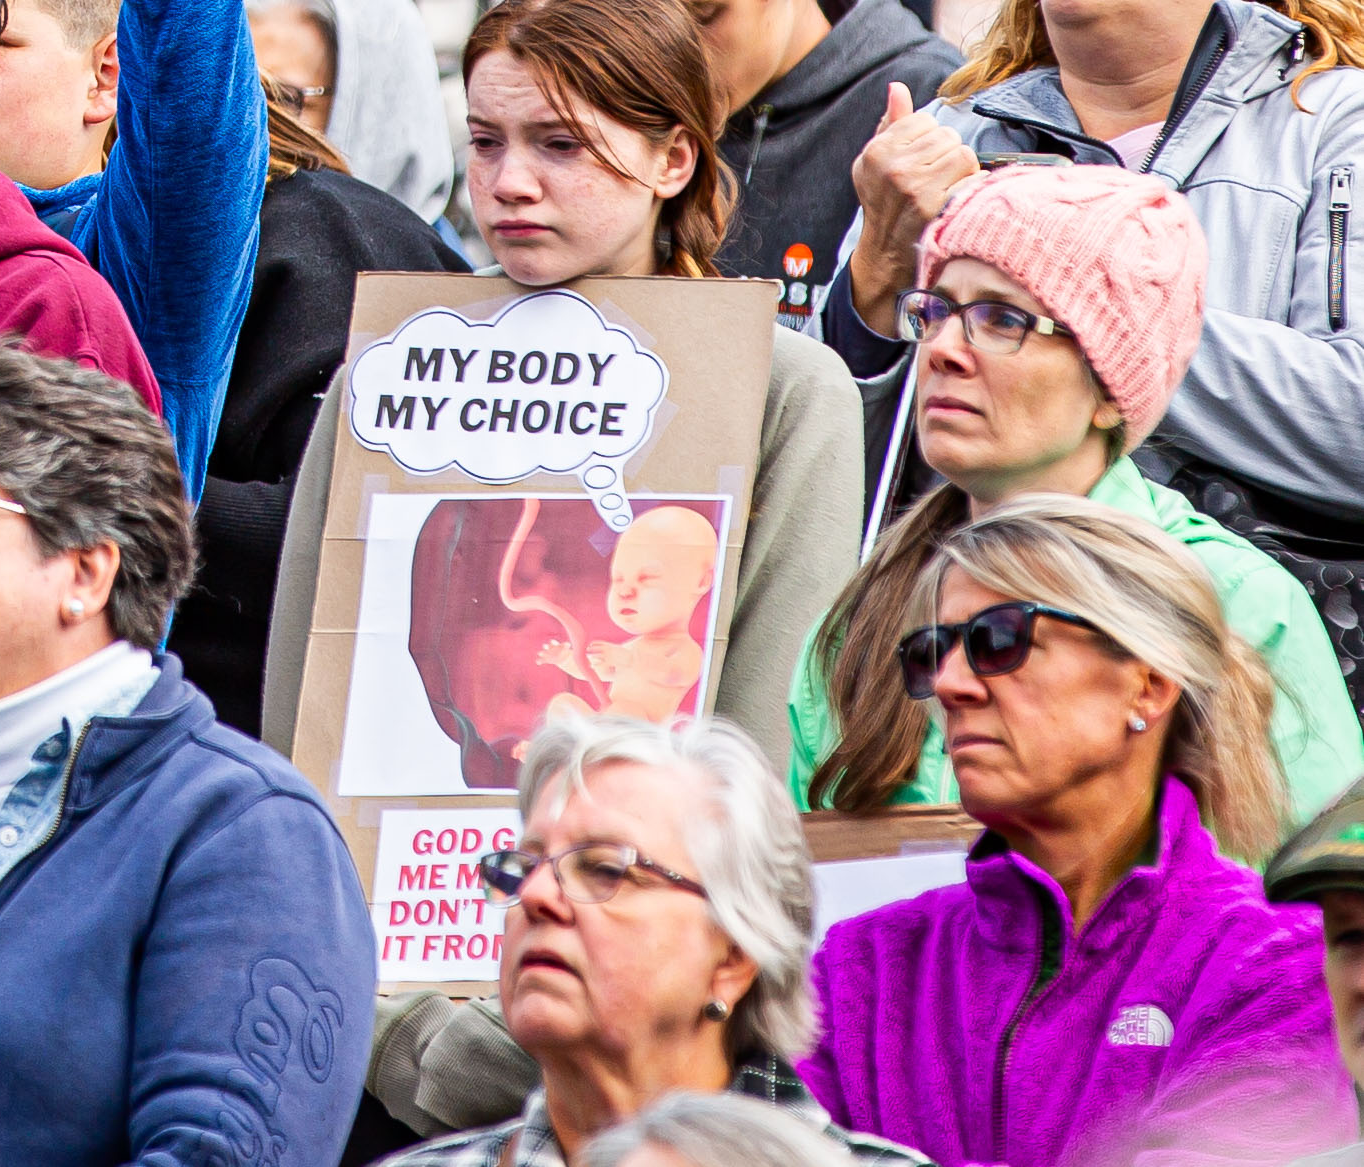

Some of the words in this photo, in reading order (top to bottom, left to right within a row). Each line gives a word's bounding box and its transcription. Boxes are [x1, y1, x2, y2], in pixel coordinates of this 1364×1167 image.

[404, 347, 479, 383] MY
[487, 349, 617, 386] BODY
[375, 394, 450, 431] MY
[460, 398, 628, 436] CHOICE
[412, 829, 483, 856] GOD
[398, 864, 449, 891] ME
[389, 898, 487, 927] DON'T
[381, 935, 416, 961] IT
